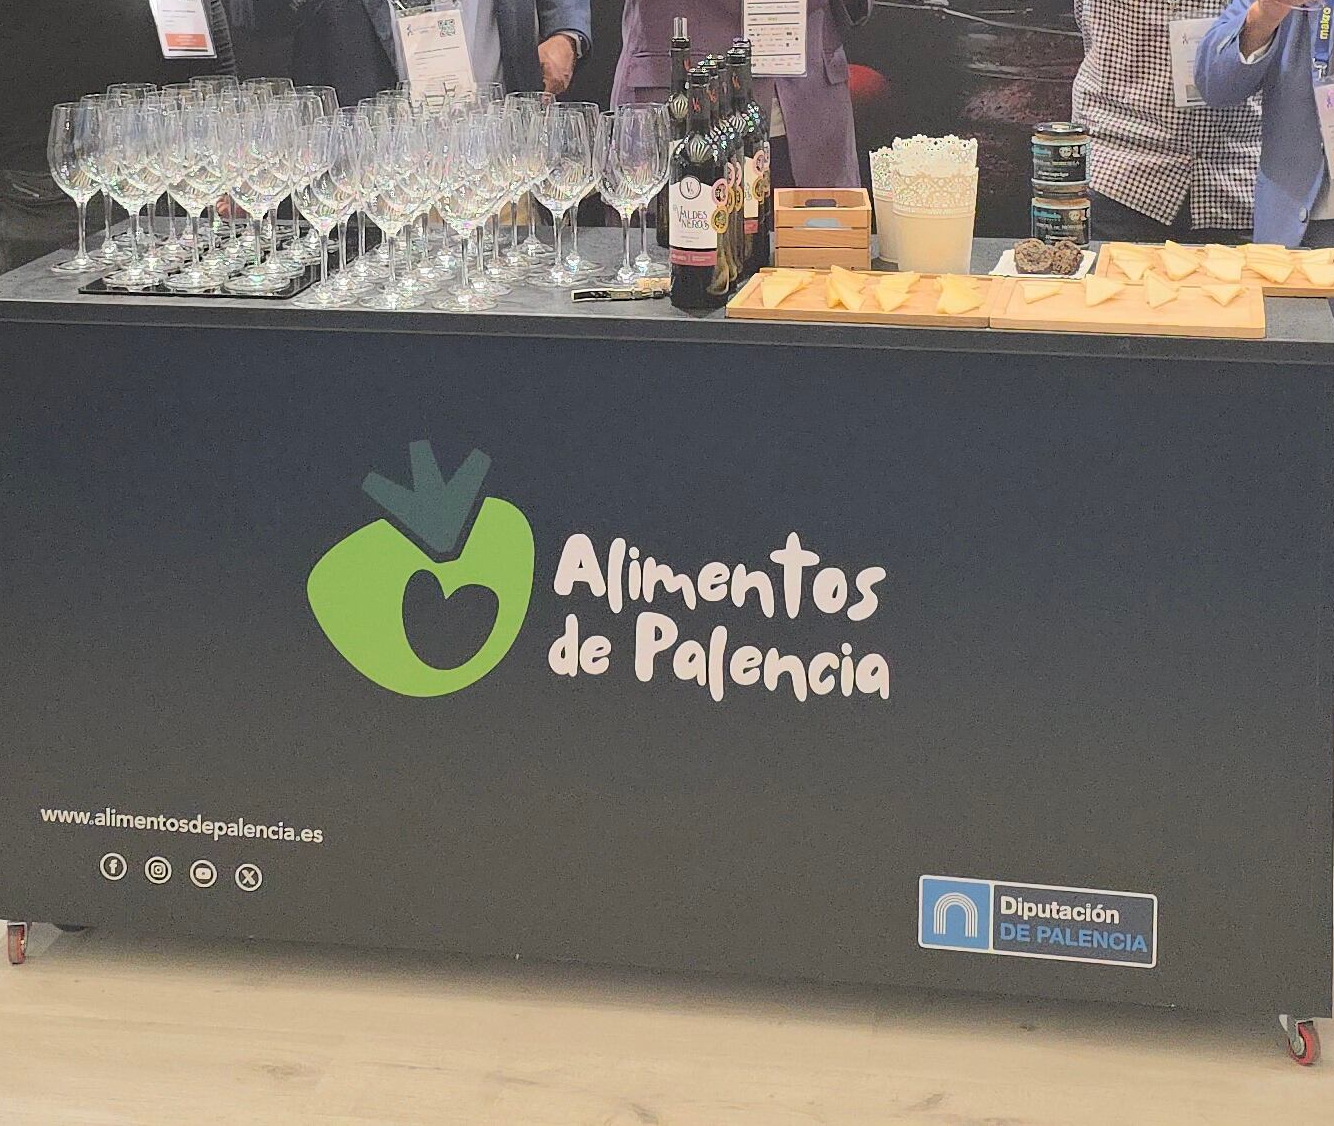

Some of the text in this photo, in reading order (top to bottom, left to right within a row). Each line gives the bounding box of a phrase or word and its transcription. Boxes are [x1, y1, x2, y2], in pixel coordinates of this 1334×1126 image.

[1319, 6, 1332, 40] makro
[554, 531, 887, 621] Alimentos
[548, 611, 890, 702] de Palencia
[40, 807, 324, 844] www.alimentosdepalencia.es
[999, 895, 1120, 924] Diputación
[999, 923, 1148, 953] DE PALENCIA
